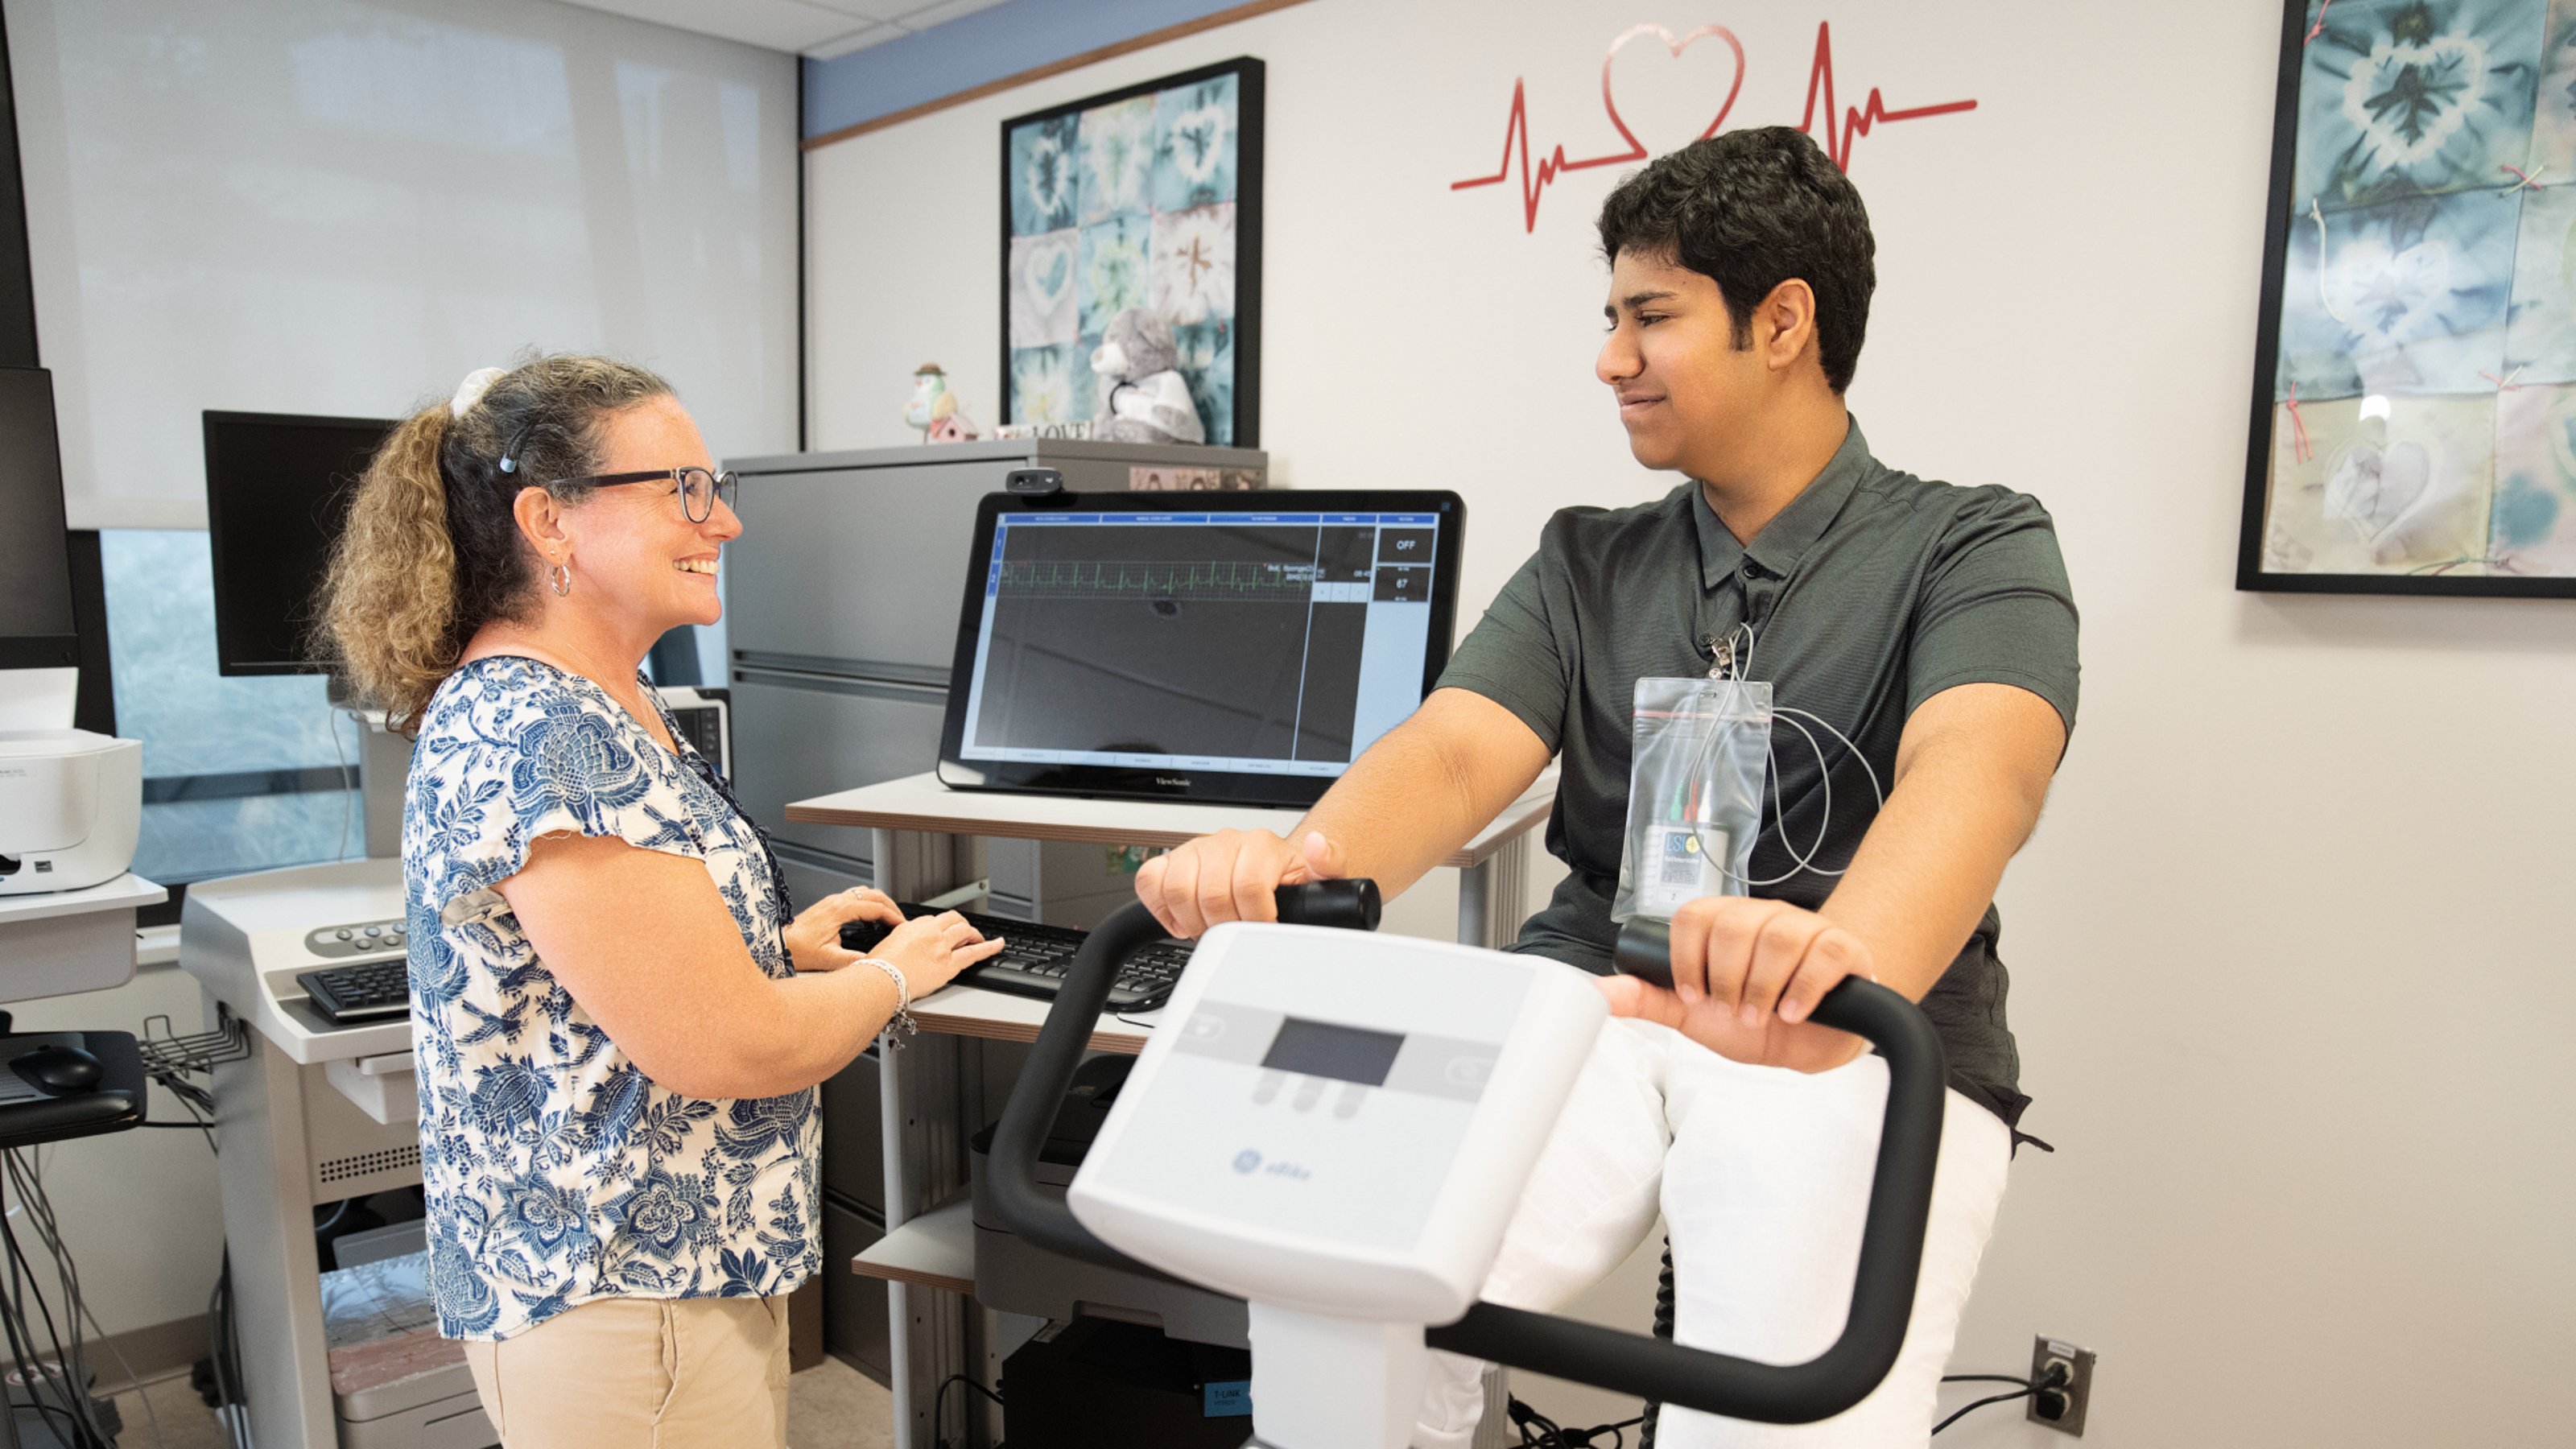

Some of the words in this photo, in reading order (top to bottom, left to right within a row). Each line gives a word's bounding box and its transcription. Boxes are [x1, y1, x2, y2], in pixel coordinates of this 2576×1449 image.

[1397, 540, 1416, 551] OFF
[1156, 778, 1191, 786] ViewSonic
[1666, 835, 1686, 851] LSI
